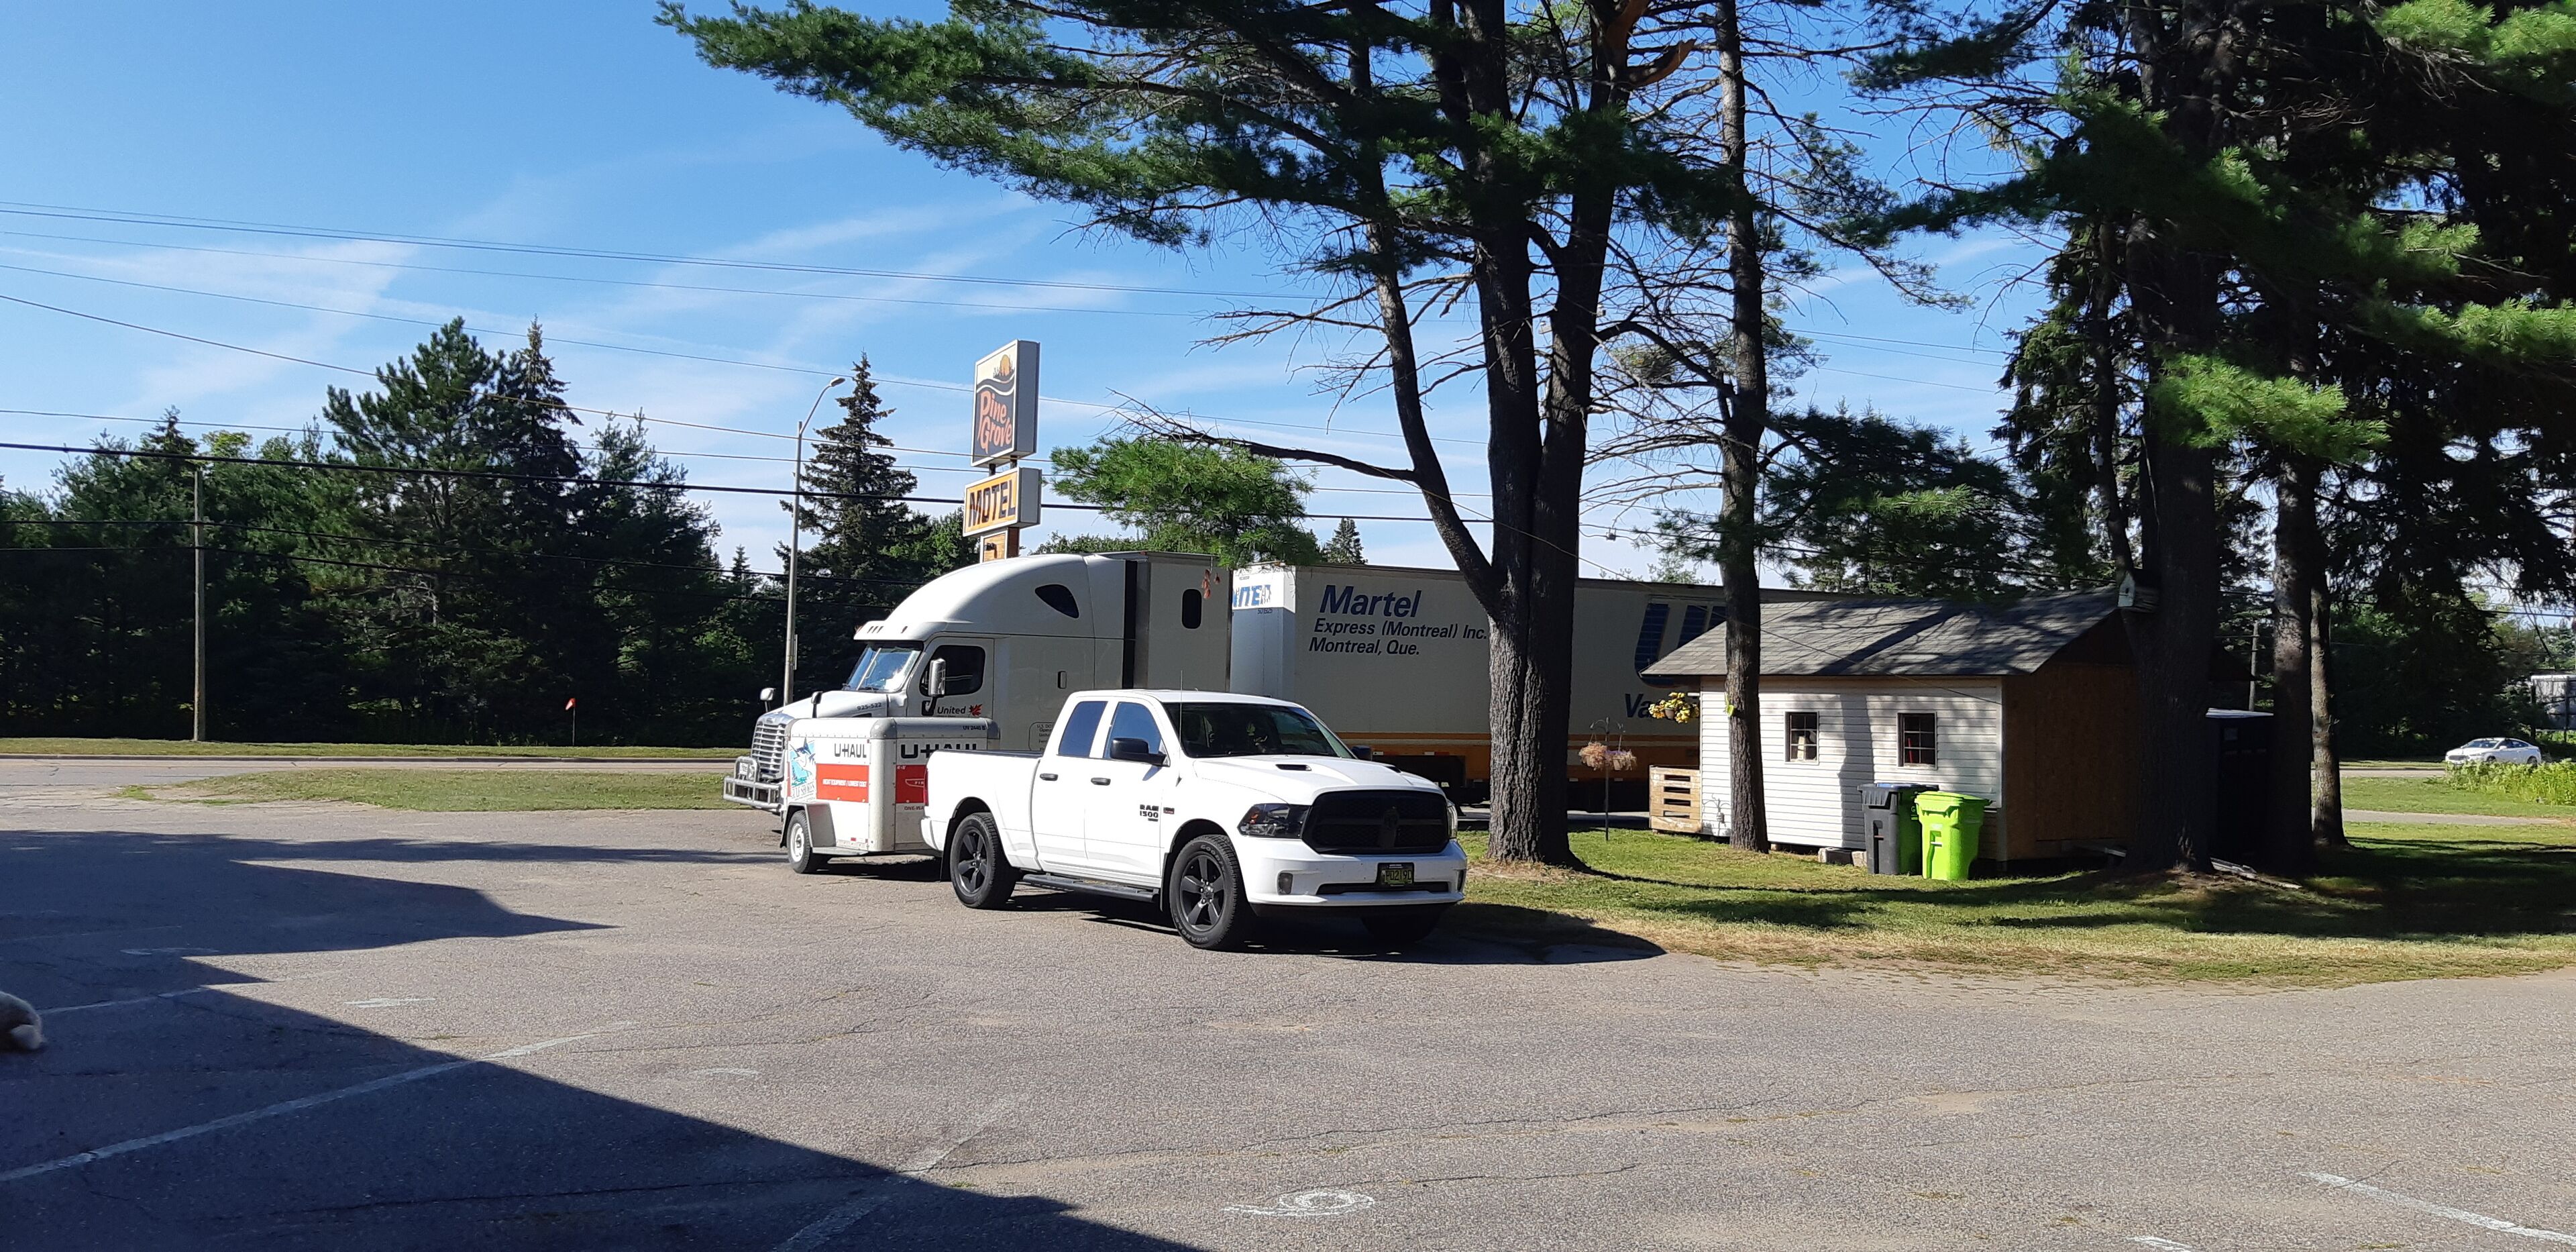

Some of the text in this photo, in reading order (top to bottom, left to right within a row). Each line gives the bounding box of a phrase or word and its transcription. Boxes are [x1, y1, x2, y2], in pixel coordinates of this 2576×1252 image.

[977, 390, 1007, 440] Pine
[980, 416, 1012, 454] Grove
[968, 479, 1016, 527] MOTEL
[1320, 584, 1421, 617] Martel
[1314, 617, 1487, 639] Express (Montreal) Inc.
[1309, 637, 1419, 656] Montreal, Que.
[857, 702, 881, 711] 925-522
[937, 706, 966, 715] United
[835, 743, 867, 758] U-HAUL
